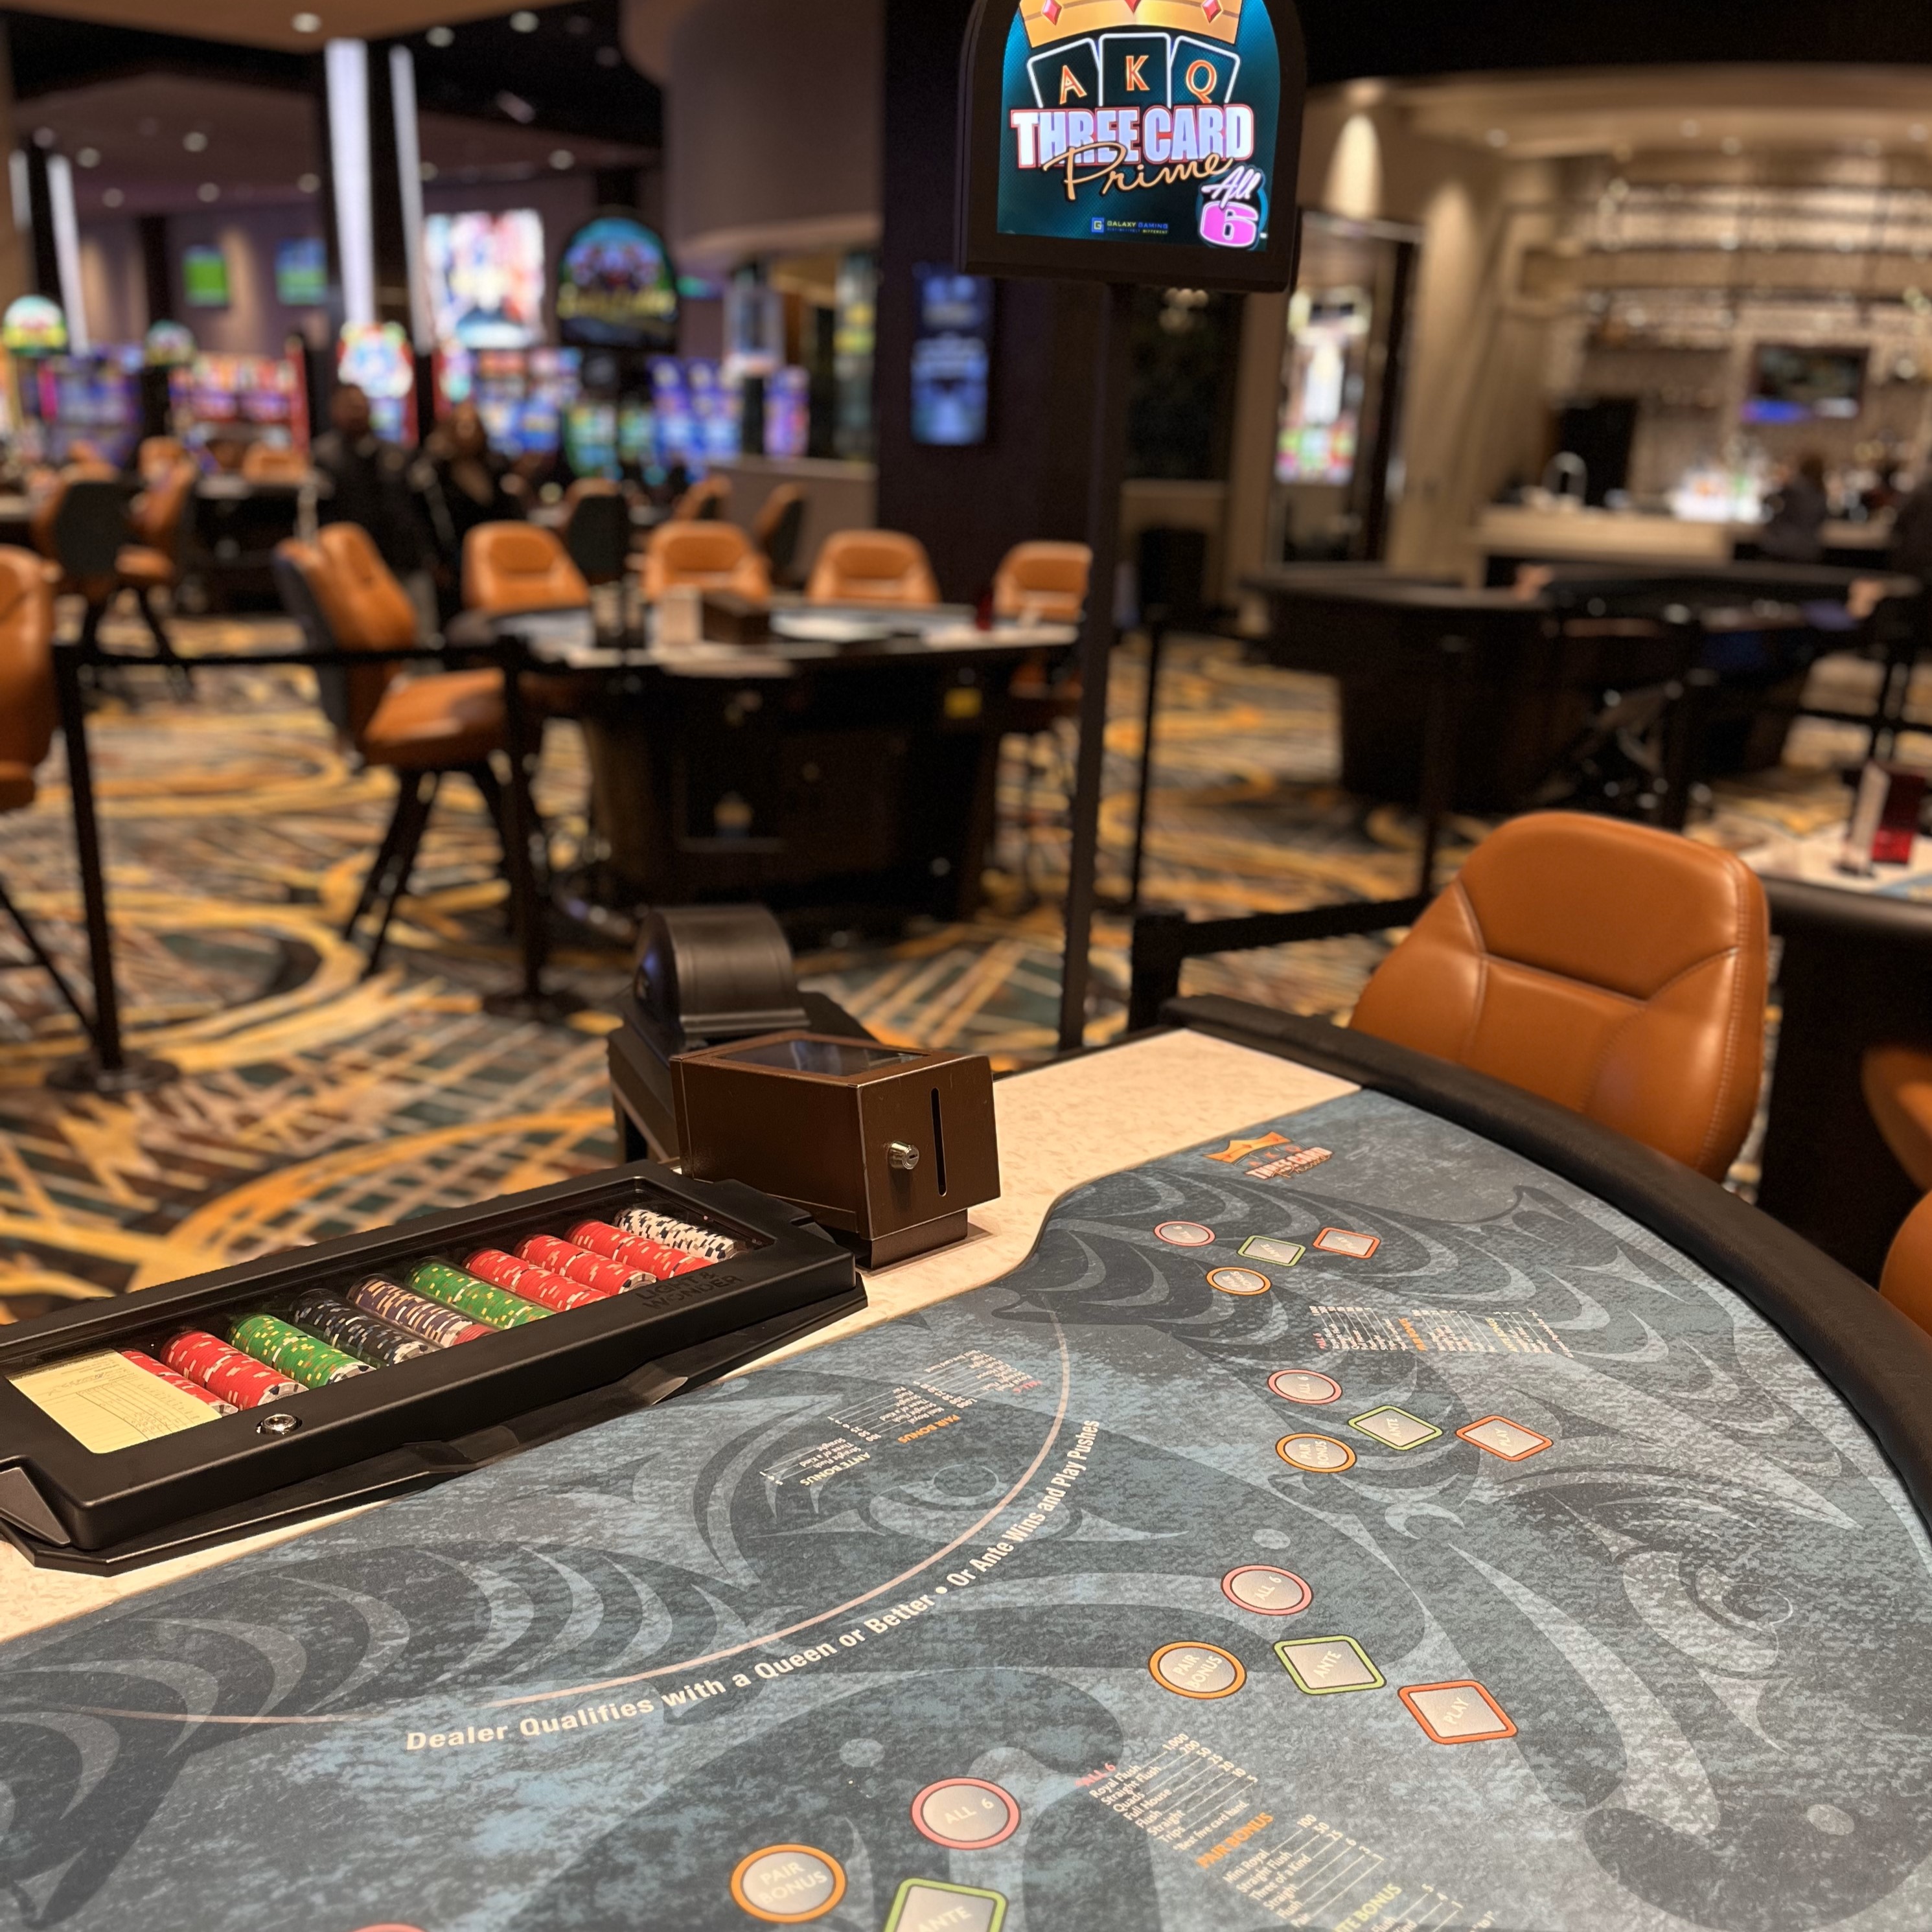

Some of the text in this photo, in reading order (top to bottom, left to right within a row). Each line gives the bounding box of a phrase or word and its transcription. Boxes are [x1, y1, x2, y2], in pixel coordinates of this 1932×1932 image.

[1059, 54, 1217, 105] A K Q
[1010, 104, 1254, 168] THREE CARD
[1042, 141, 1234, 201] Prime
[1201, 165, 1261, 209] All
[1200, 201, 1259, 247] 6
[635, 1274, 697, 1300] LIGHT
[642, 1274, 744, 1309] WONDER
[865, 1433, 882, 1442] 100
[898, 1414, 960, 1443] PAIR BONUS
[1387, 1417, 1402, 1438] ANTE
[1495, 1428, 1510, 1447] PLAY
[800, 1452, 871, 1486] ANTE BONUS
[1300, 1443, 1311, 1461] PAIR
[1316, 1440, 1330, 1466] BONUS
[406, 1420, 1100, 1751] Dealer Qualifies with a Queen or Better Or Ante Wins and Play Pushes
[1255, 1575, 1283, 1602] ALL 6
[1173, 1653, 1202, 1677] PAIR
[1186, 1655, 1223, 1690] BONUS
[1312, 1650, 1342, 1679] ANTE
[1443, 1696, 1471, 1725] PLAY
[1088, 1733, 1189, 1798] Royal Flush 1,000
[1101, 1740, 1200, 1806] Straight Flush 200
[1104, 1762, 1116, 1772] 6
[1112, 1747, 1212, 1812] Quads 50
[1123, 1754, 1223, 1821] Full House 25
[1134, 1761, 1235, 1828] Flush 20
[1147, 1767, 1247, 1836] Straight 10
[944, 1798, 995, 1824] ALL 6
[1156, 1775, 1258, 1843] Trips 5
[1193, 1825, 1213, 1839] five
[1210, 1813, 1230, 1828] card
[1195, 1812, 1274, 1870] PAIR BONUS
[1222, 1813, 1317, 1883] Mini Royal 100
[1236, 1822, 1330, 1892] Straight Flush 50
[760, 1861, 807, 1886] PAIR
[1248, 1881, 1278, 1901] Three
[1275, 1870, 1287, 1883] of
[1287, 1853, 1312, 1872] Kind
[1326, 1829, 1343, 1841] 25
[1263, 1837, 1357, 1911] Straight 6
[1276, 1845, 1371, 1919] Flush 3
[759, 1870, 828, 1905] BONUS
[1290, 1853, 1385, 1928] Pair 1
[1353, 1883, 1402, 1922] BONUS
[1421, 1883, 1434, 1892] 5
[1451, 1900, 1464, 1909] 1
